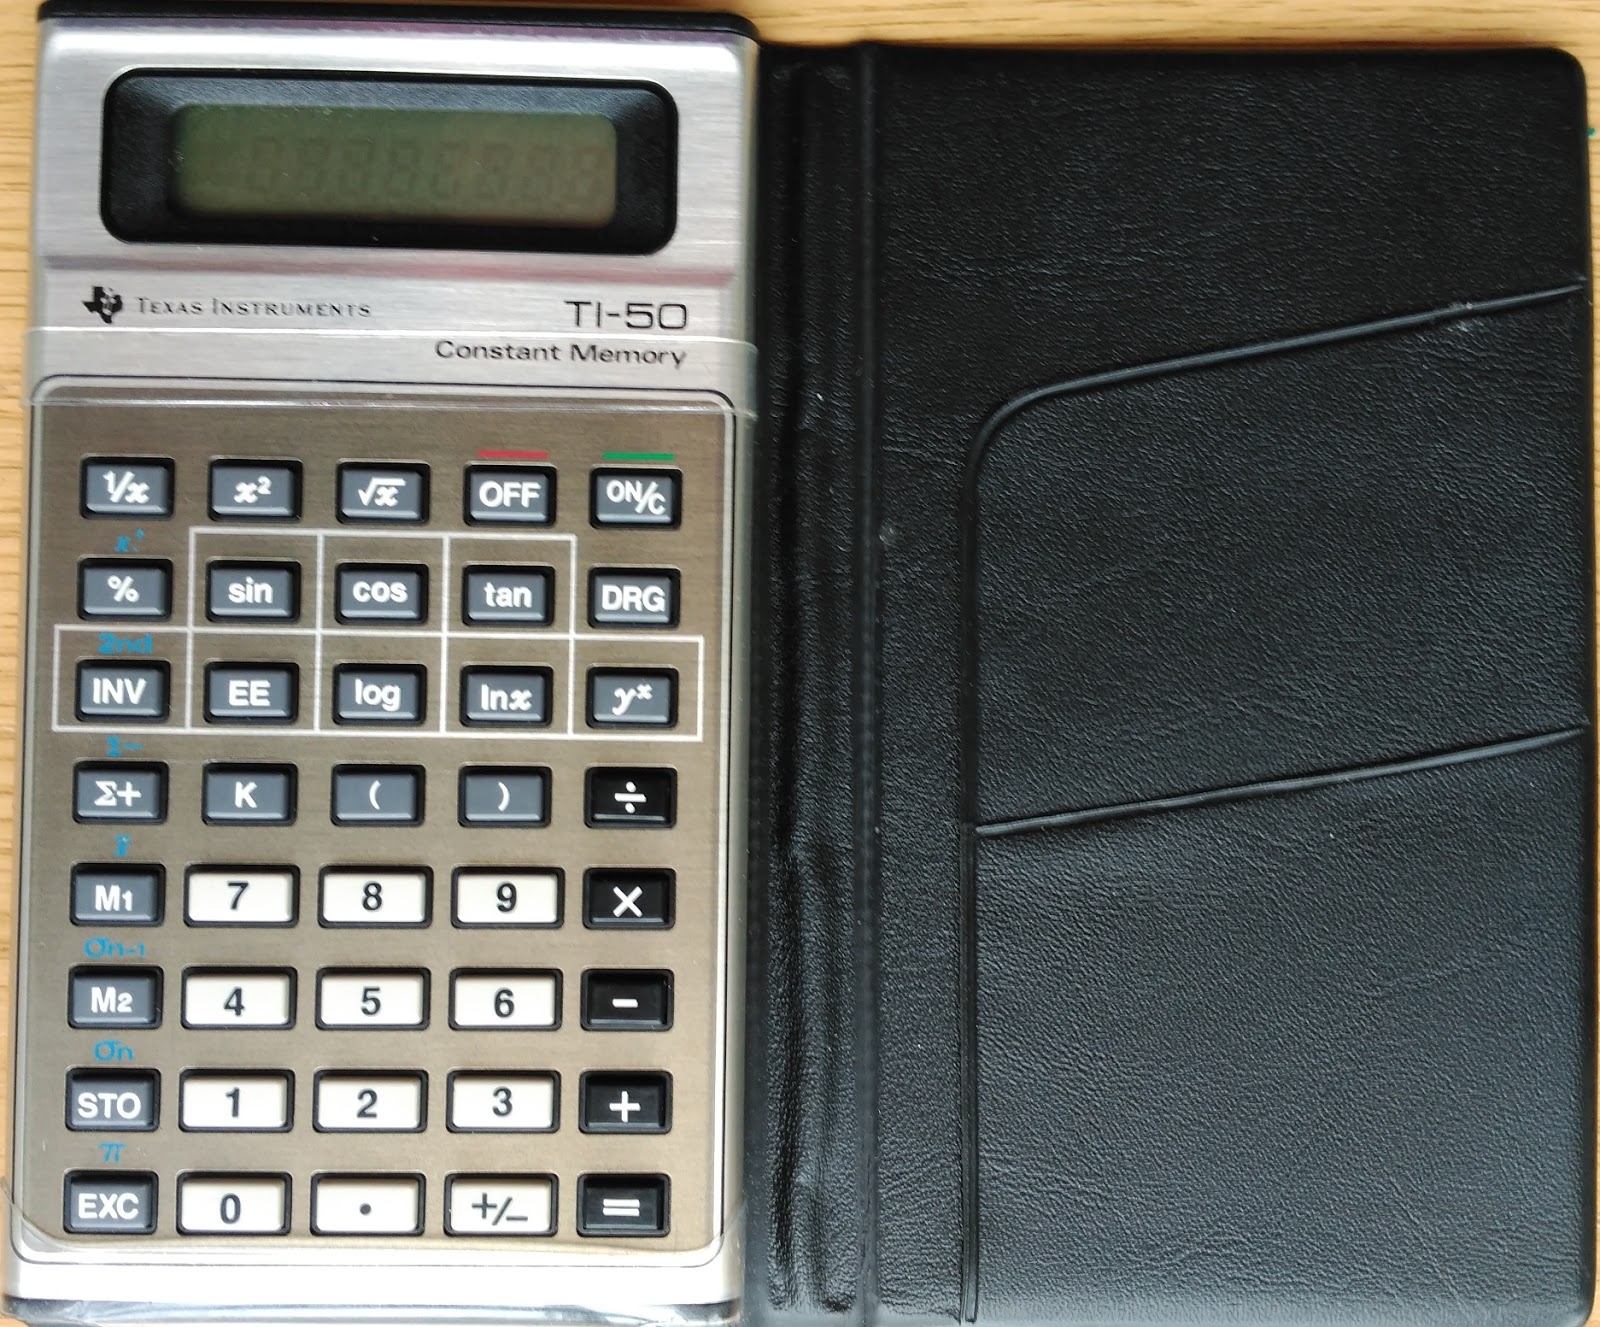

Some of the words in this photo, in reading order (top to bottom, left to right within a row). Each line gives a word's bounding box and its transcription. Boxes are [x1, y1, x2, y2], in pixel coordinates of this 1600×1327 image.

[564, 301, 687, 330] TI-50
[435, 341, 560, 360] Constant
[571, 344, 686, 368] Memory
[479, 481, 541, 507] OFF
[108, 576, 139, 602] %
[228, 577, 273, 603] sin
[353, 581, 408, 602] cos
[484, 582, 532, 607] tan
[602, 585, 665, 612] DRG
[98, 633, 153, 654] 2nd
[93, 678, 146, 704] INV
[229, 680, 270, 706] EE
[353, 678, 401, 711] log
[235, 781, 257, 808] K
[369, 781, 381, 810] (
[498, 782, 510, 811] )
[95, 885, 132, 911] M1
[228, 882, 248, 909] 7
[363, 882, 382, 910] 8
[497, 883, 516, 912] 9
[91, 986, 133, 1013] M2
[224, 988, 244, 1015] 4
[362, 988, 380, 1015] 5
[495, 989, 514, 1017] 6
[76, 1092, 142, 1119] STO
[227, 1089, 239, 1116] 1
[358, 1090, 377, 1117] 2
[493, 1088, 512, 1116] 3
[610, 1091, 640, 1122] +
[77, 1194, 140, 1220] EXC
[221, 1195, 240, 1223] 0
[603, 1199, 640, 1216] =
